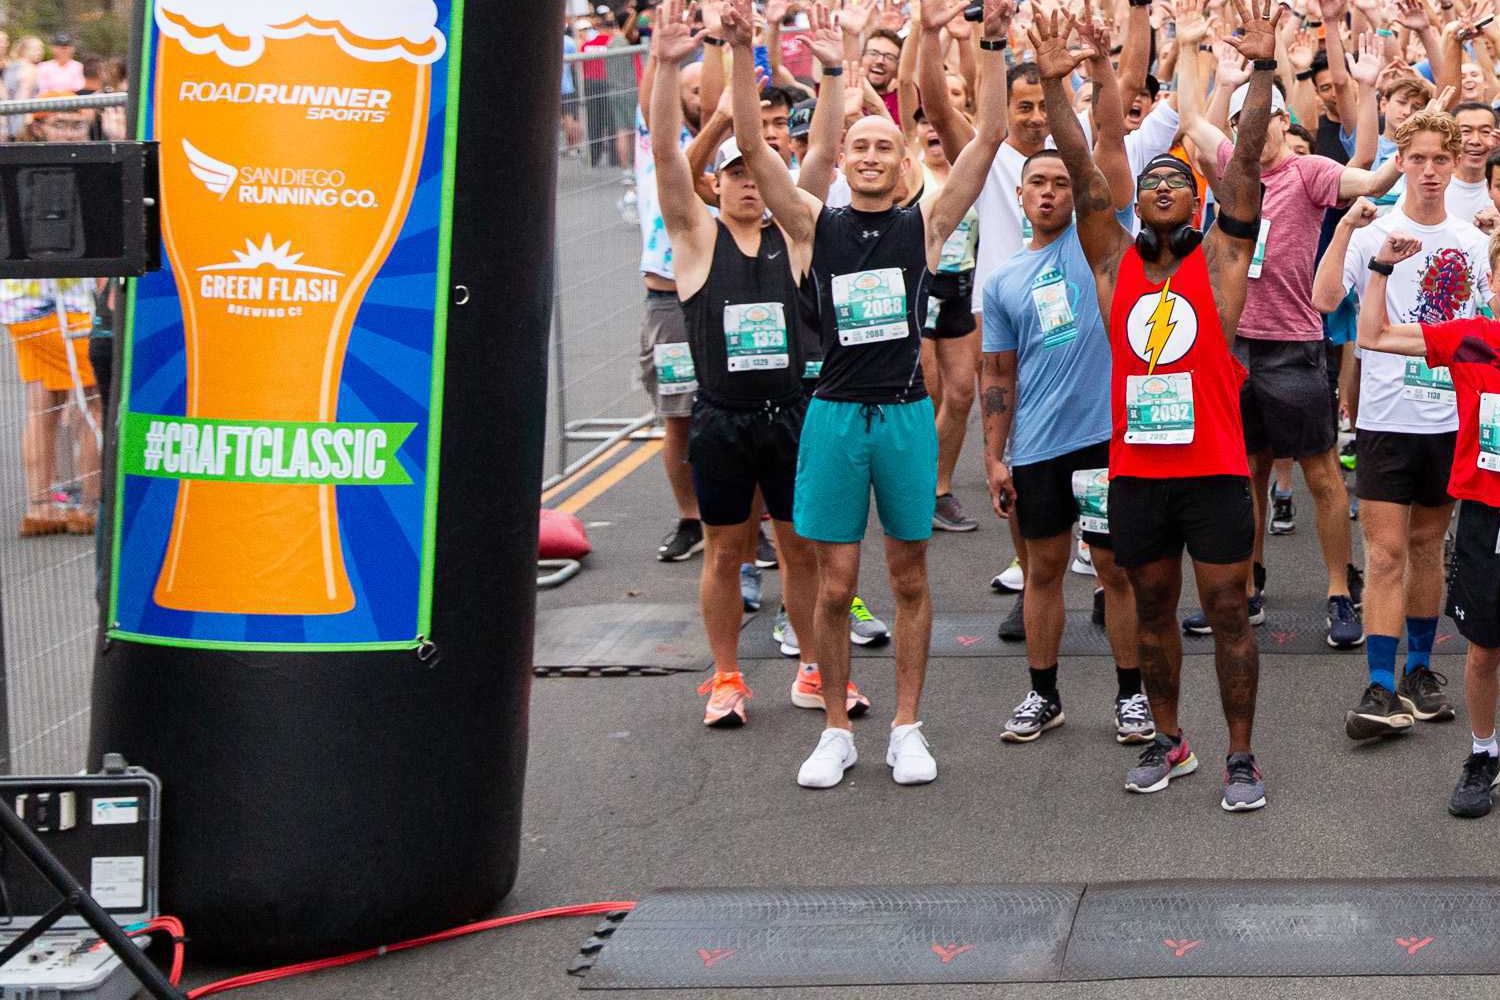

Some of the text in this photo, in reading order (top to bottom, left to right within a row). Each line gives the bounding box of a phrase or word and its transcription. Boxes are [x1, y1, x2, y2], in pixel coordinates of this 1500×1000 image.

[305, 107, 388, 123] SPORTS
[239, 166, 346, 187] SAN DIEGO
[239, 185, 339, 206] RUNNING
[201, 275, 338, 304] GREEN FLASH
[227, 303, 285, 318] BREWING
[144, 420, 388, 480] #CRAFTCLASSIC
